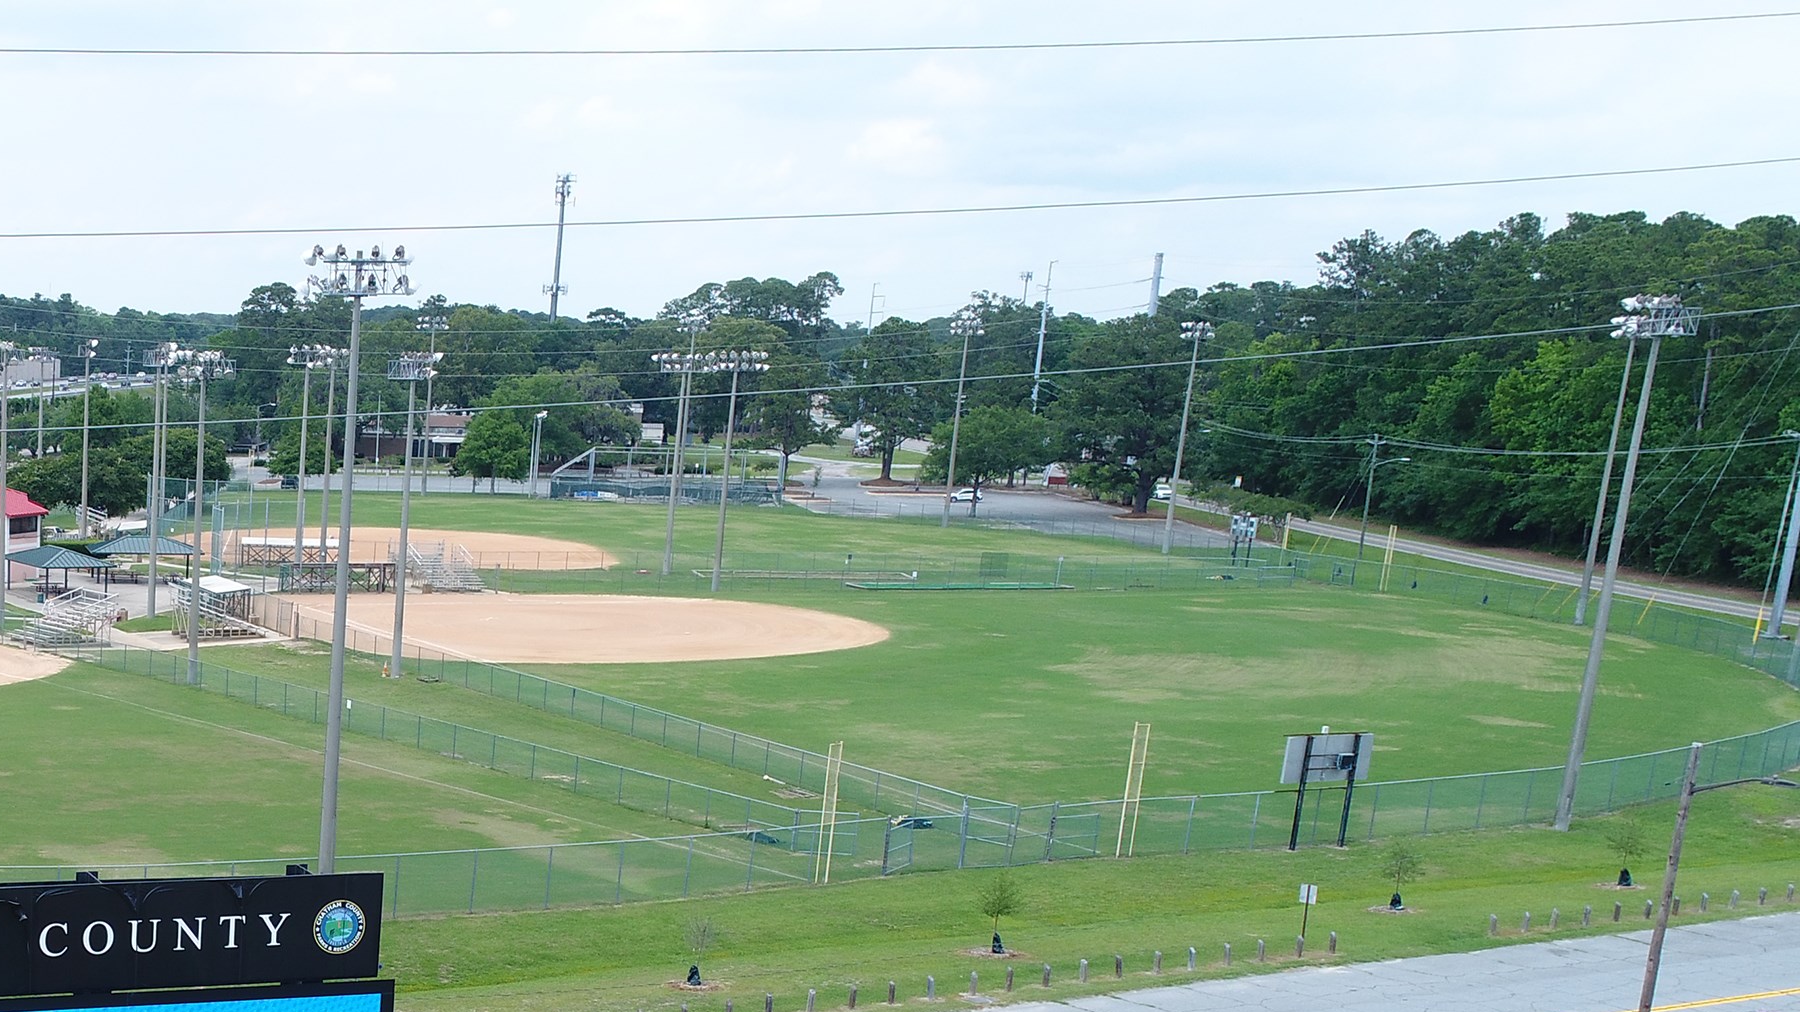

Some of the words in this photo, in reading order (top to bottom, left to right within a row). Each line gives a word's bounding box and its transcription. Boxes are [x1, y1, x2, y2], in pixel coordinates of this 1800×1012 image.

[316, 902, 342, 926] CHATHAM
[345, 902, 363, 924] COUNTY
[38, 911, 292, 958] COUNTY
